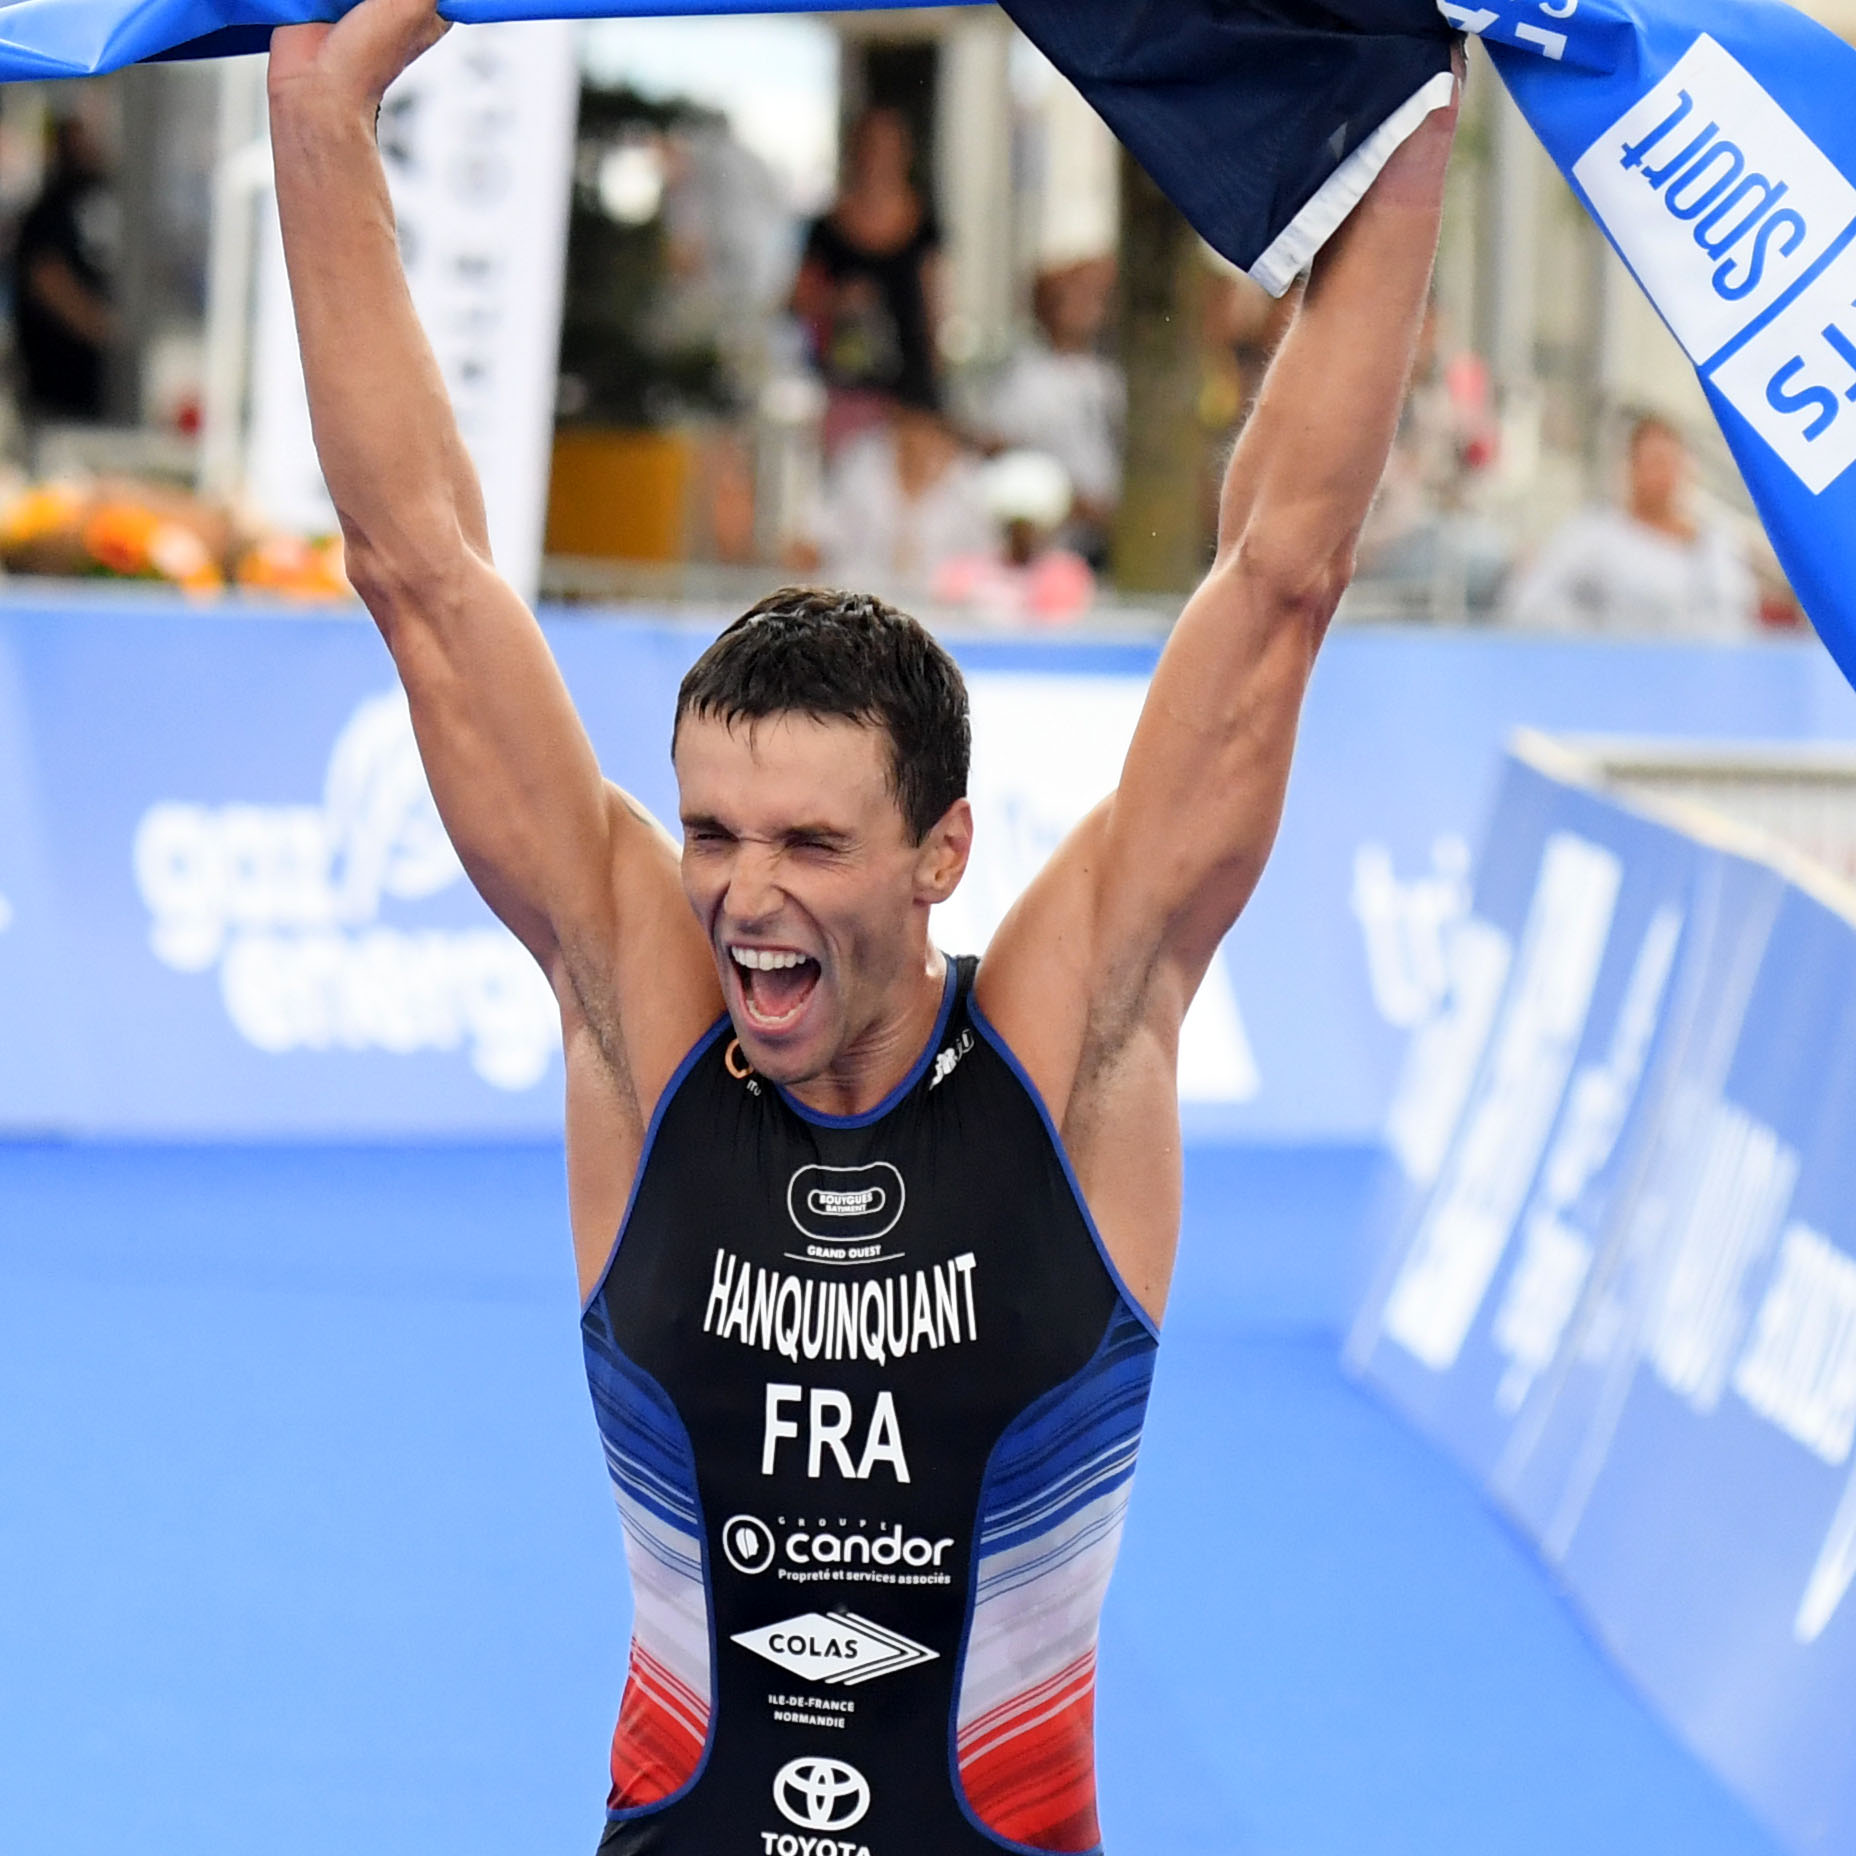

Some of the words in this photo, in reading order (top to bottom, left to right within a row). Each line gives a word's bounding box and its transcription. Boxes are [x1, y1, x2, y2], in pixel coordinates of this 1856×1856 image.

[1617, 88, 1809, 302] Sport
[807, 1245, 846, 1259] GRAND
[848, 1245, 882, 1259] OUEST
[704, 1249, 977, 1368] HANQUINQUANT
[761, 1382, 912, 1485] FRA
[778, 1516, 888, 1532] GROUPE
[785, 1523, 955, 1568] candor
[778, 1567, 832, 1584] Propreté
[832, 1570, 845, 1582] et
[846, 1571, 896, 1585] services
[898, 1573, 952, 1585] associés
[768, 1633, 859, 1660] COLAS
[768, 1694, 855, 1713] ILE-DE-FRANCE
[773, 1711, 846, 1729] NORMANDIE
